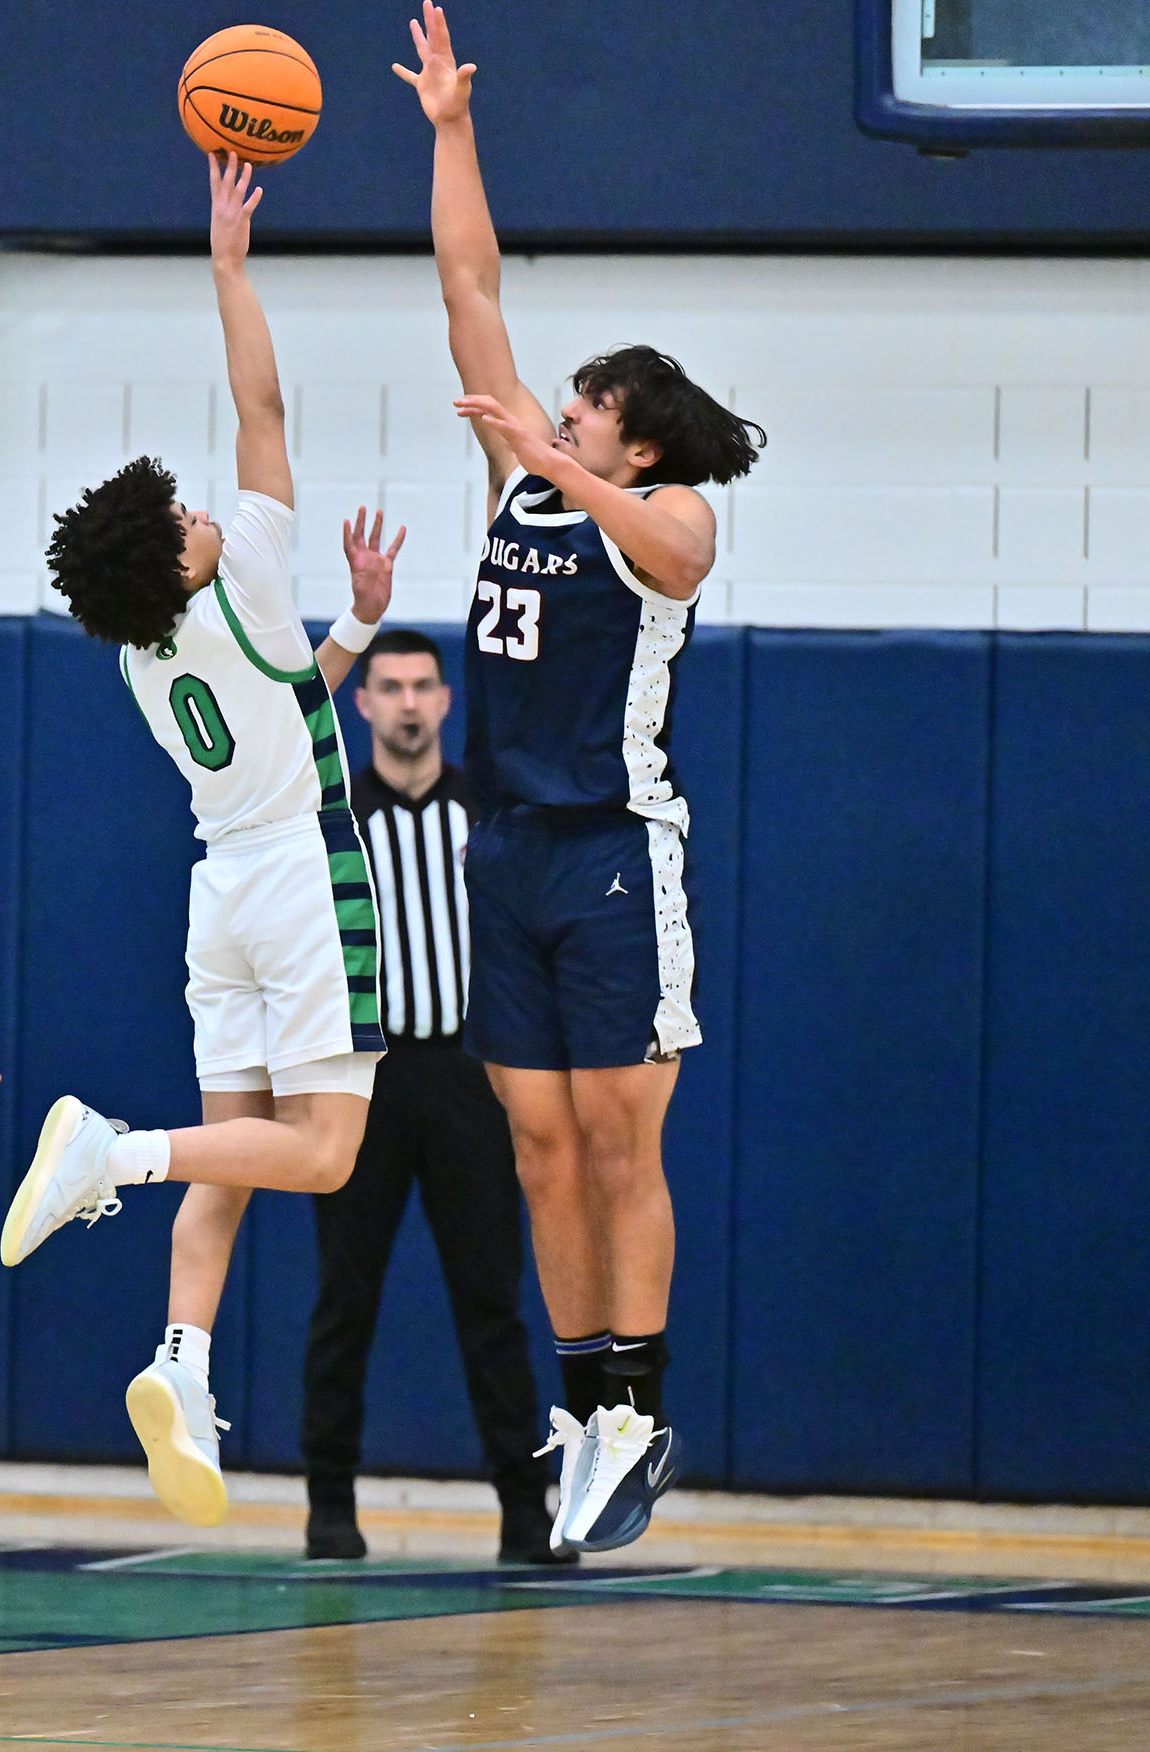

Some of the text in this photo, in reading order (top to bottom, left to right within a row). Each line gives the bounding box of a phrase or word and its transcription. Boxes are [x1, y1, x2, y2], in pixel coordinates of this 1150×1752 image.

[218, 103, 305, 144] Wilson
[476, 580, 541, 661] 23
[168, 672, 236, 772] 0
